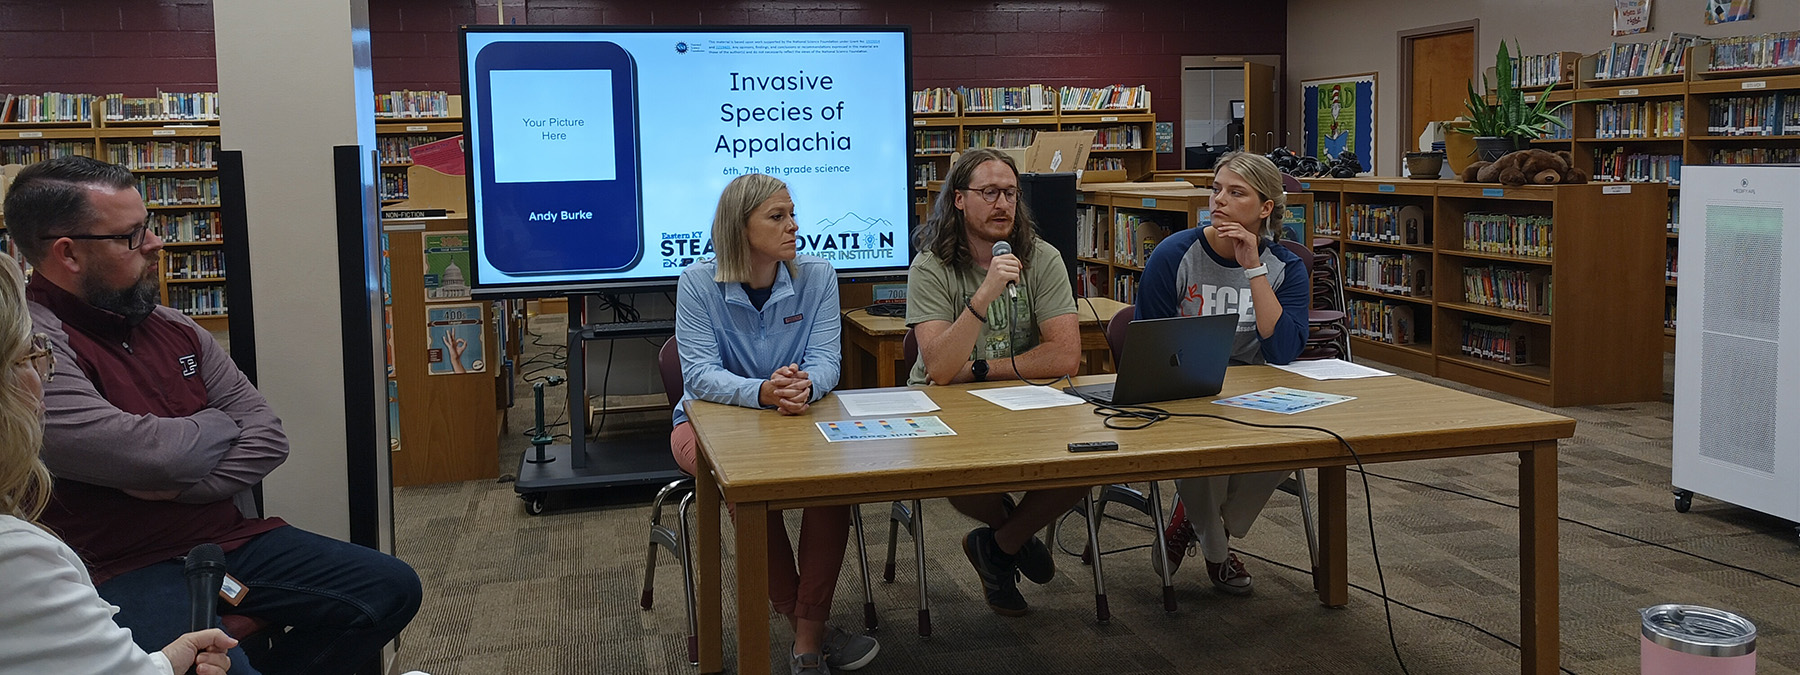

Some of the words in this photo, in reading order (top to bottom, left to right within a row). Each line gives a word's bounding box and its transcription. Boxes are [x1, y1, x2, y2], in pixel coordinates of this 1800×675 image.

[730, 70, 833, 91] Invasive
[720, 101, 813, 127] Species
[821, 101, 844, 121] of
[522, 118, 546, 127] Your
[549, 117, 584, 127] Picture
[542, 131, 567, 140] Here
[714, 131, 851, 158] Appalachia
[722, 166, 742, 176] 6th,
[765, 166, 780, 174] 8th
[783, 165, 812, 176] grade
[815, 164, 850, 173] science
[529, 211, 558, 223] Andy
[561, 210, 592, 220] Burke
[661, 238, 714, 256] STEA
[838, 248, 894, 260] INSTITUTE
